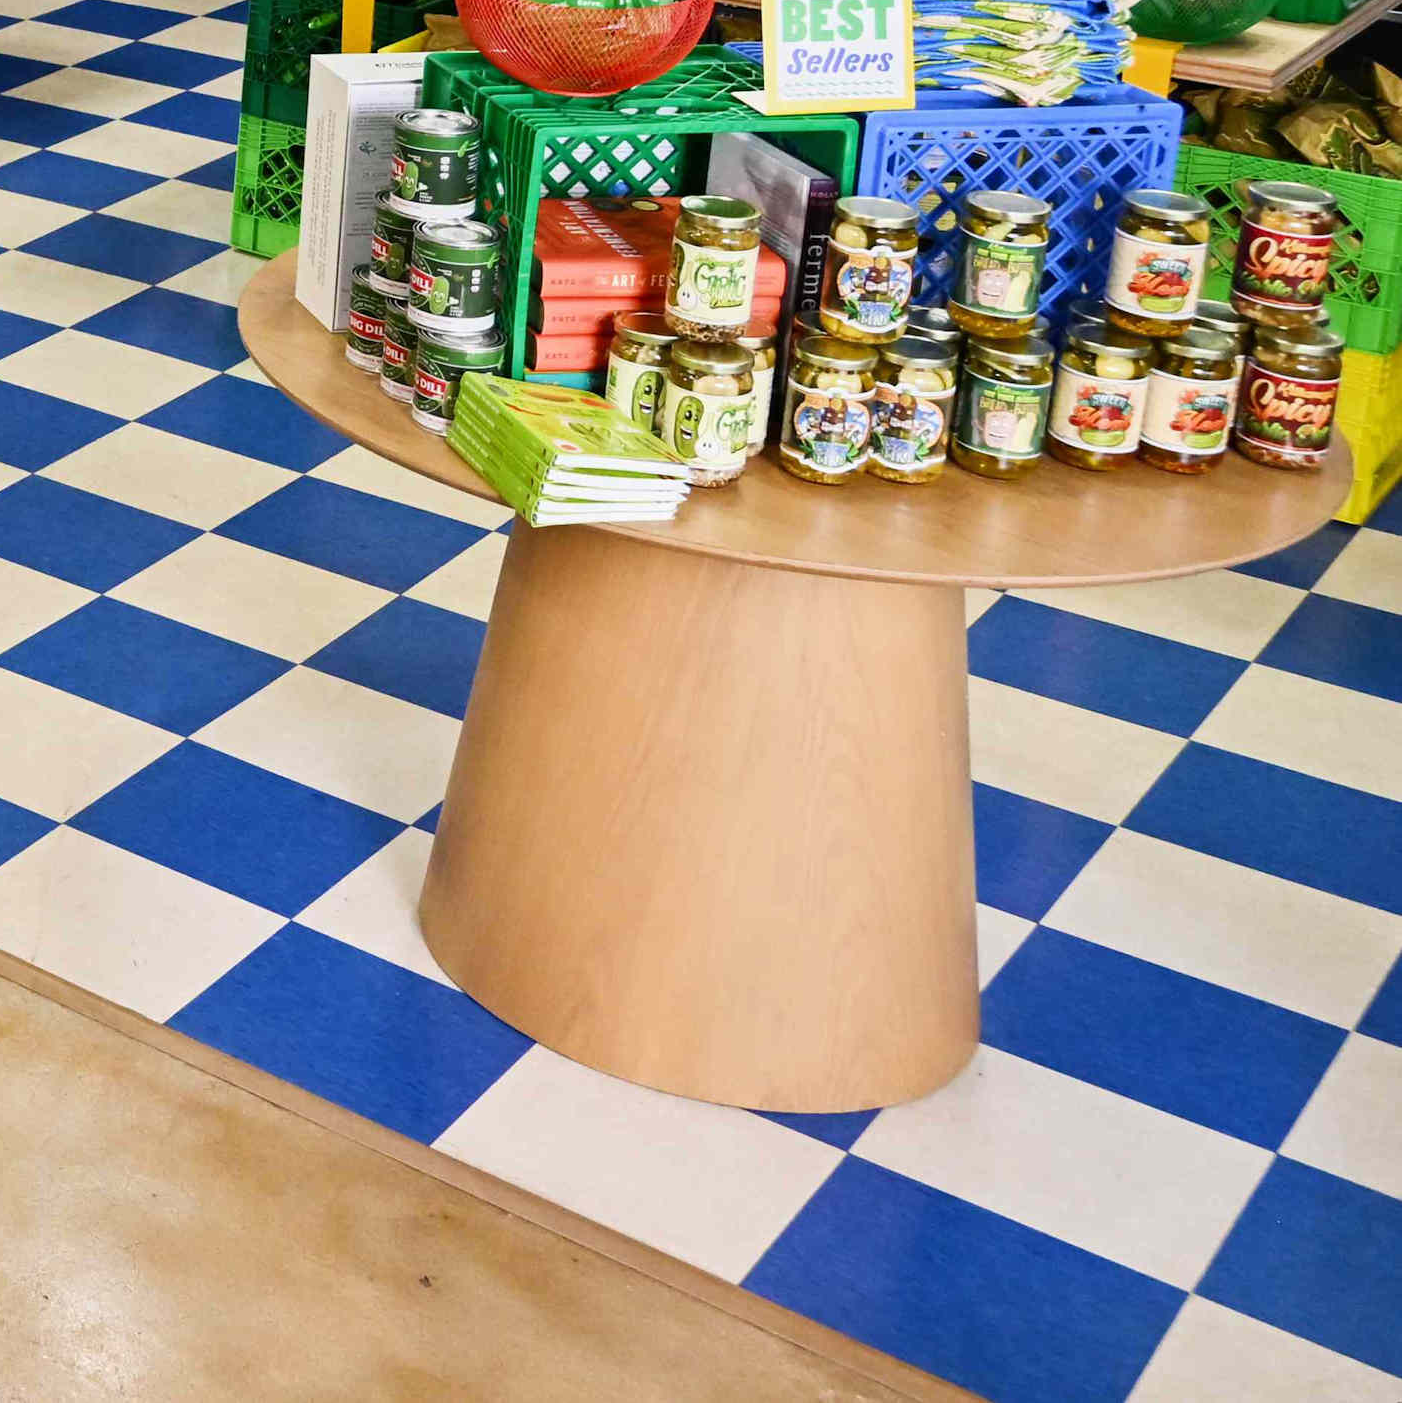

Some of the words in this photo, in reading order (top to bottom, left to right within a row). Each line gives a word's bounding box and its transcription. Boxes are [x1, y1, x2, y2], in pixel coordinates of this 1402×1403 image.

[786, 48, 894, 75] Sellers
[1247, 235, 1329, 288] Spicy
[611, 274, 636, 287] ART
[365, 321, 385, 336] DIL
[420, 376, 445, 395] DILL
[1249, 377, 1333, 430] Spicy
